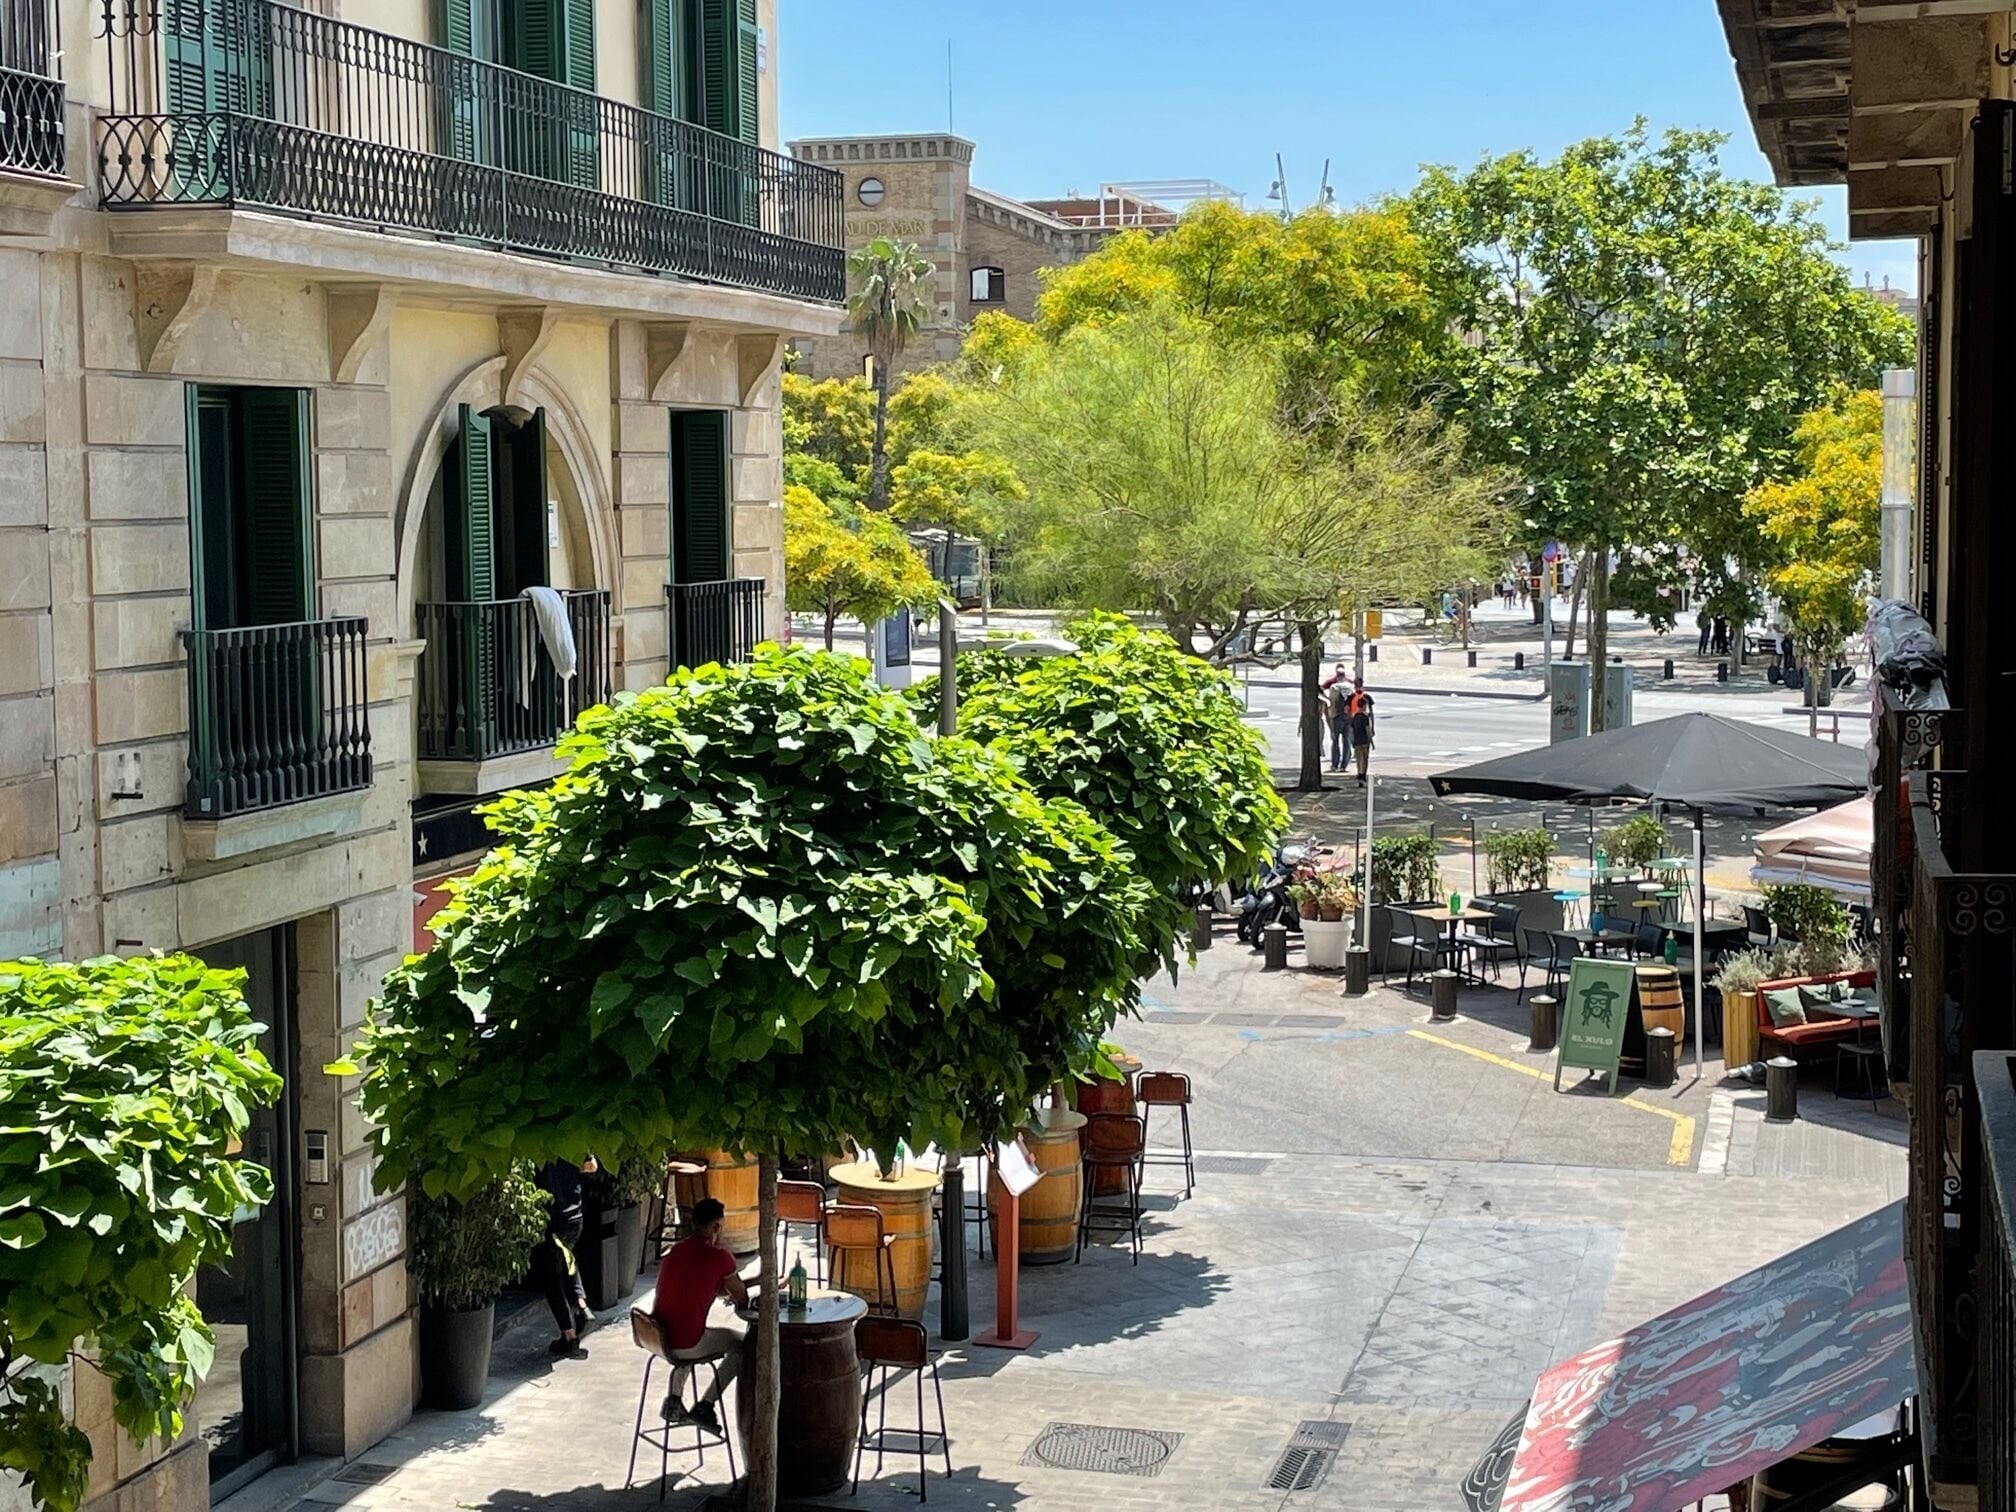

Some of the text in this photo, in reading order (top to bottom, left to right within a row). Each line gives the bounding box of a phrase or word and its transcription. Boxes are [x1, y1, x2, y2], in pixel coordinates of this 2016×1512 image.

[867, 221, 886, 235] DE
[889, 220, 924, 235] MAR
[1571, 1034, 1613, 1045] EL XULO
